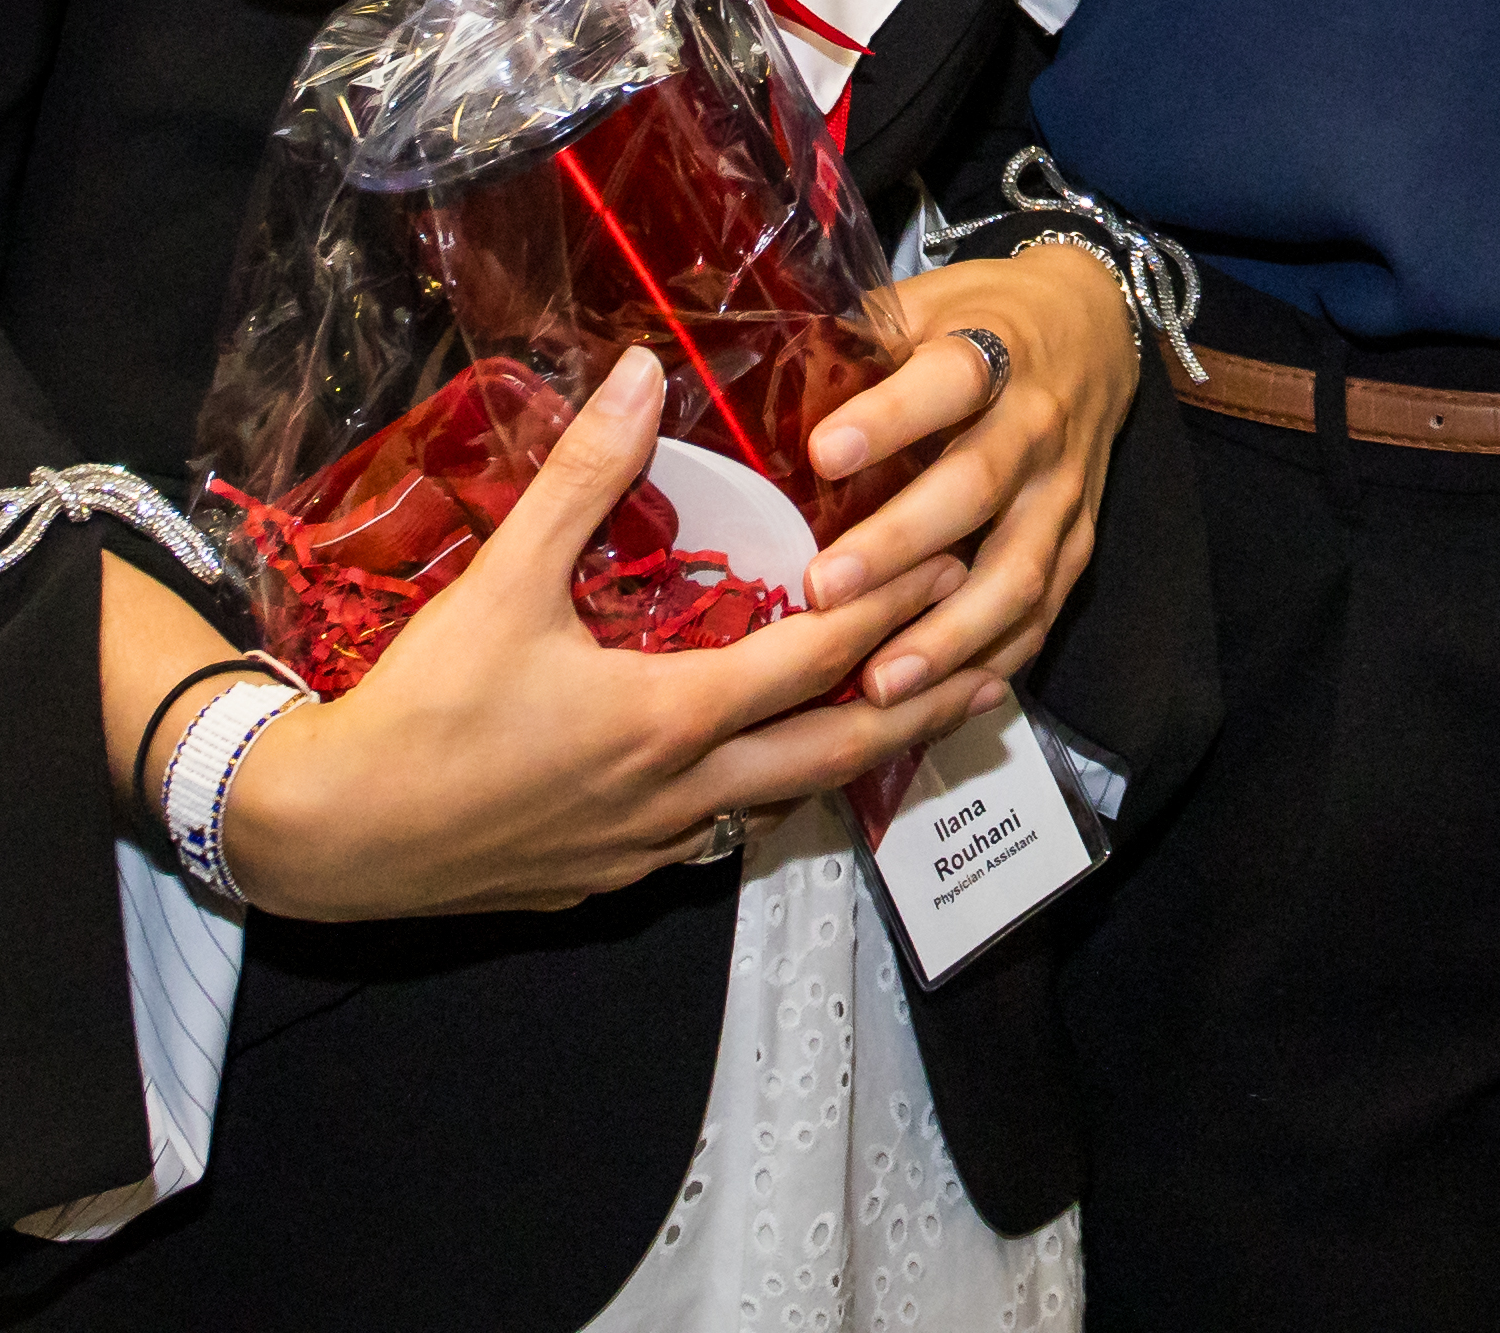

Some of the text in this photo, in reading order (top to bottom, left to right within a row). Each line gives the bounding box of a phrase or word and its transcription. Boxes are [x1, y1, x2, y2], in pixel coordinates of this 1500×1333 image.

[934, 799, 987, 842] Ilana
[934, 808, 1021, 882] Rouhani
[933, 830, 1039, 910] Physician Assistant
